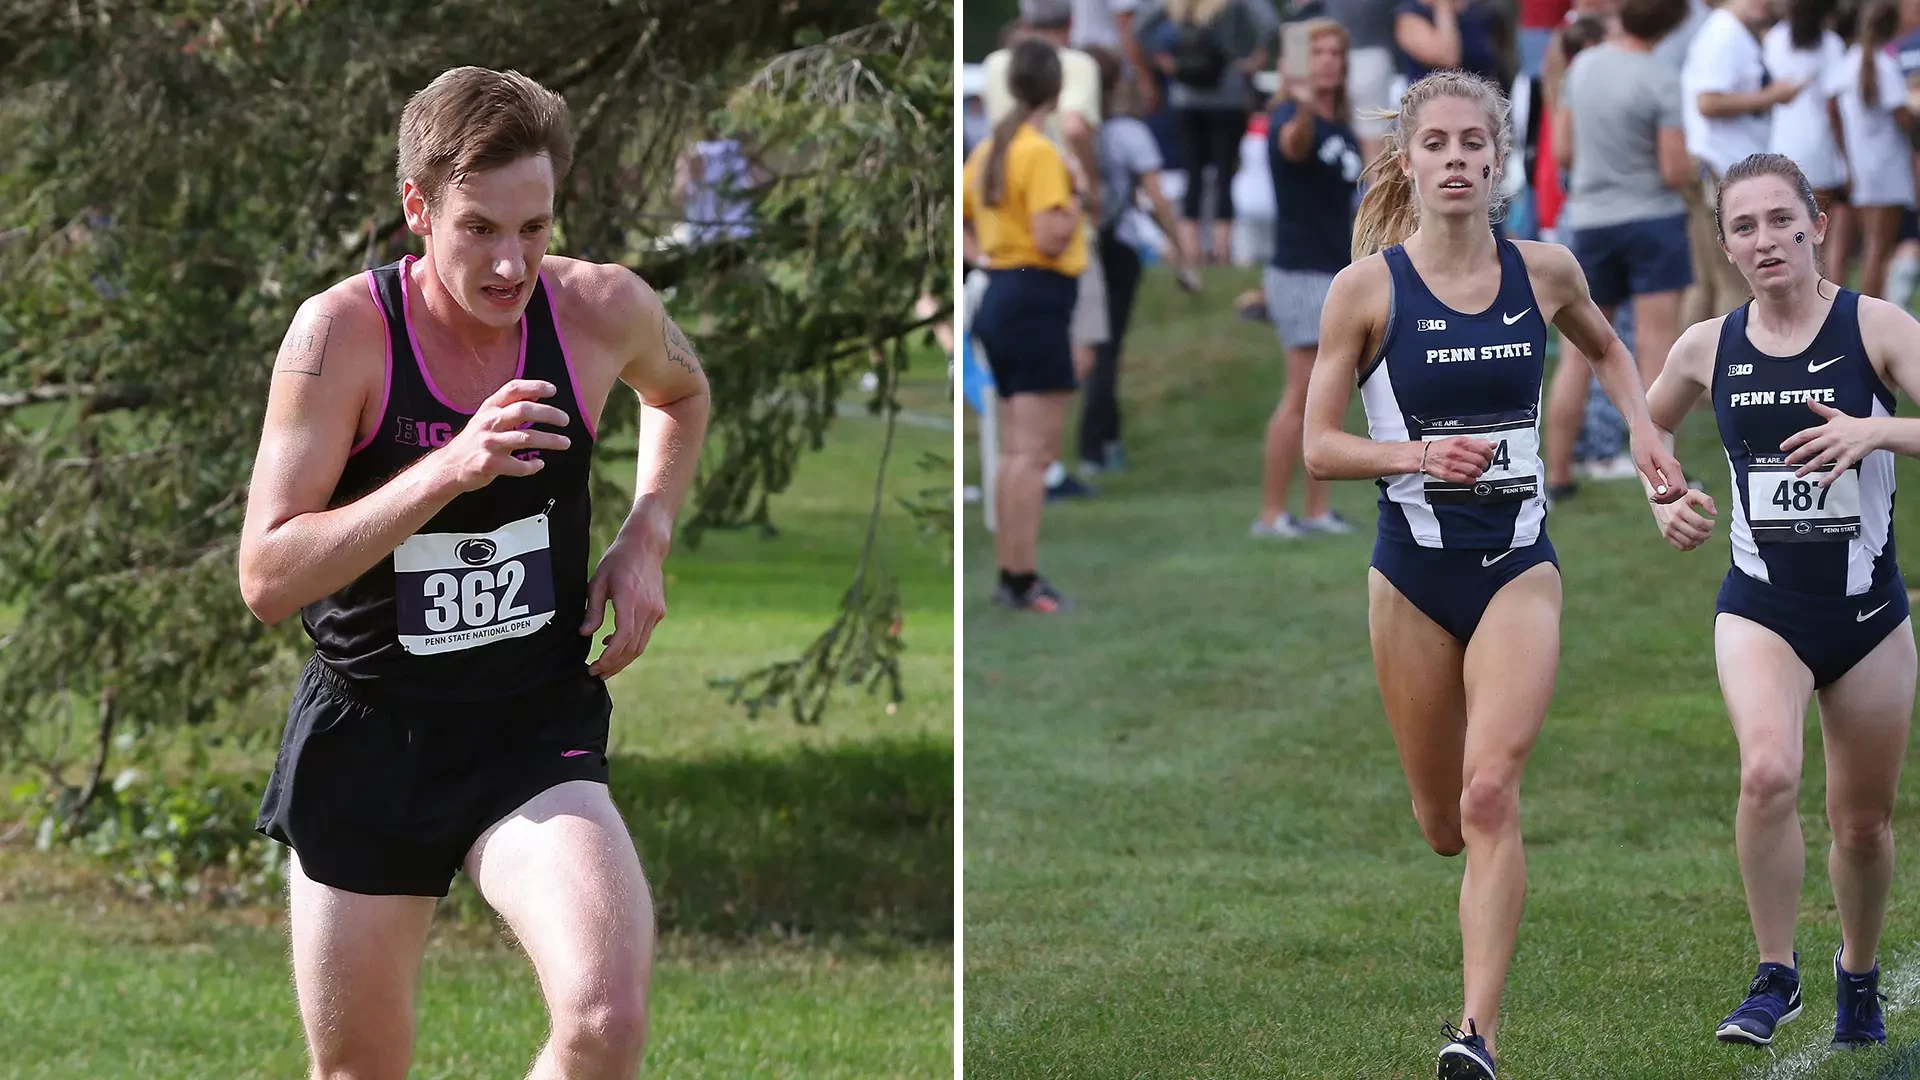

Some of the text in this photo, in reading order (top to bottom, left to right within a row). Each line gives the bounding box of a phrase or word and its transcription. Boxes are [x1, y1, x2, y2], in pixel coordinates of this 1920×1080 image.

[1426, 342, 1532, 364] PENN STATE
[1730, 388, 1835, 407] PENN STATE
[1772, 480, 1832, 511] 487
[423, 560, 530, 633] 362
[425, 620, 532, 646] PENN STATE NATIONAL OPEN
